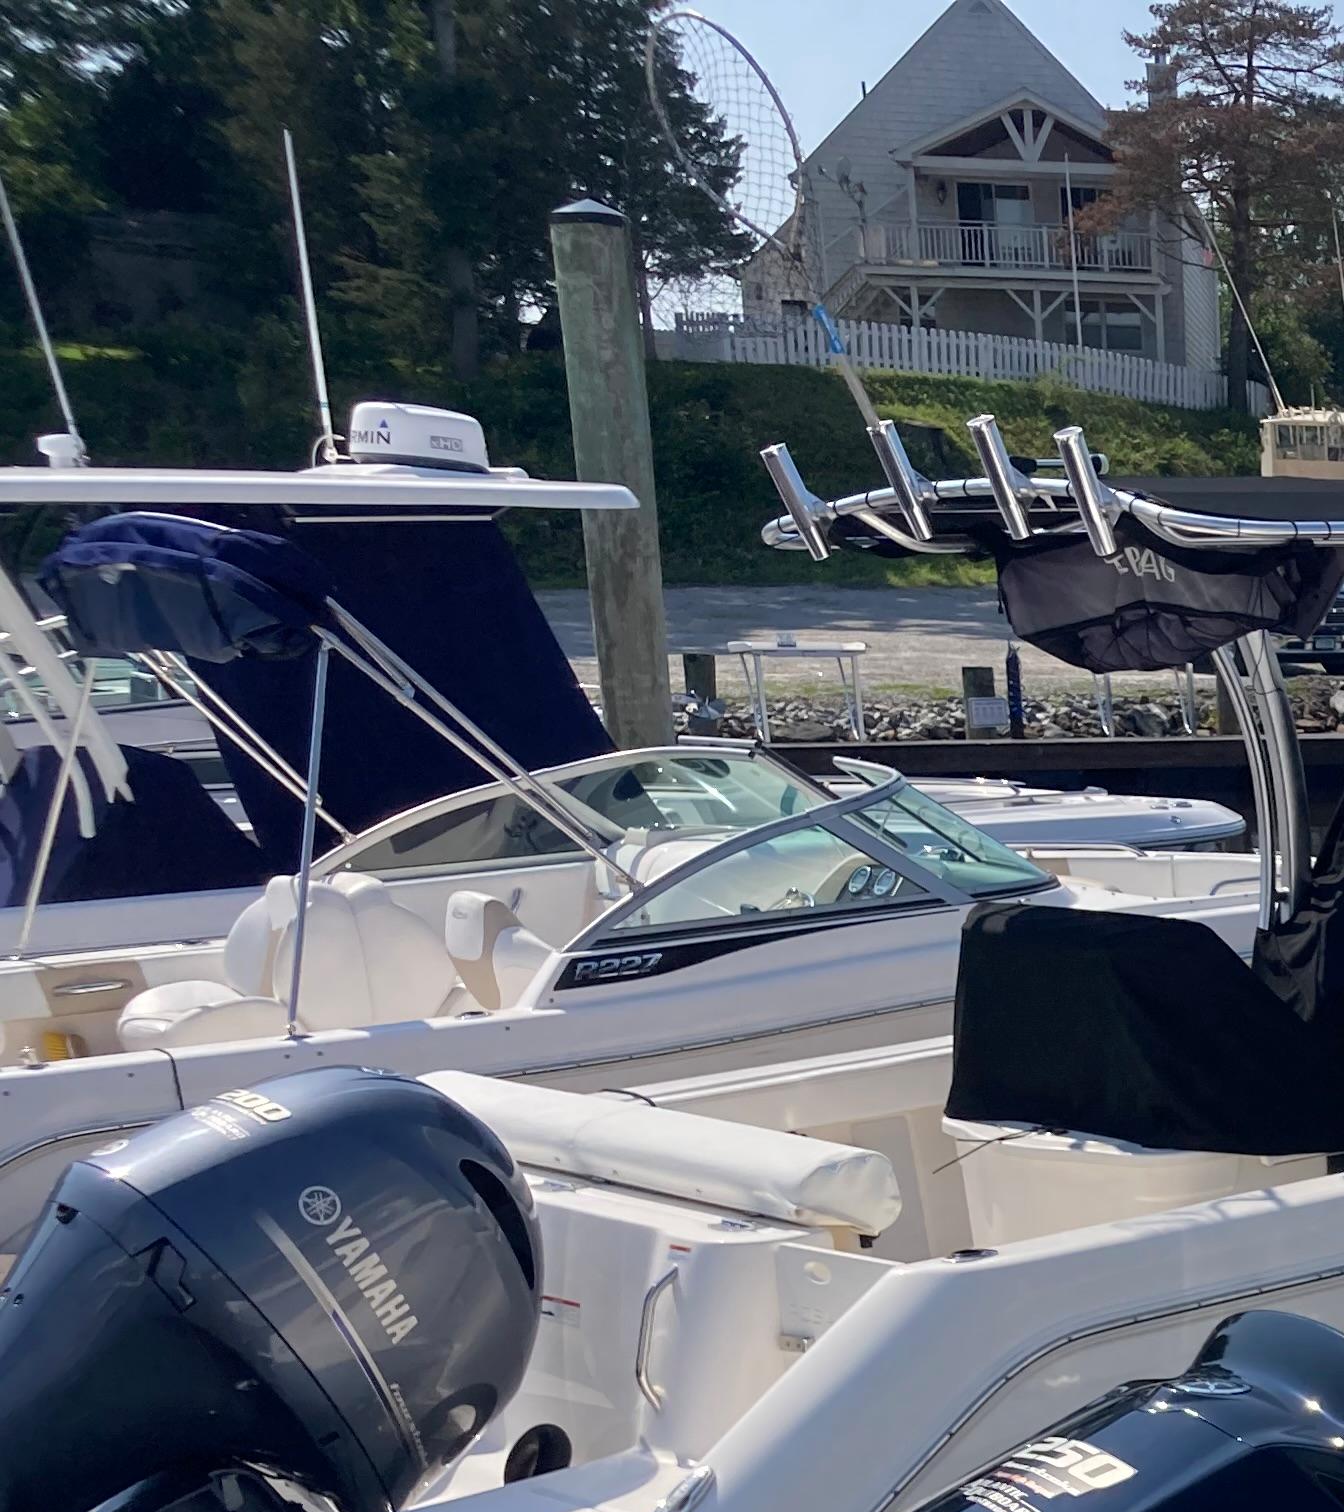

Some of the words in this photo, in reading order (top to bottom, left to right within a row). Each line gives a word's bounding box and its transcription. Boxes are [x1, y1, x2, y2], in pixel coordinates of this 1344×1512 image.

[352, 430, 391, 444] RMIN
[574, 952, 663, 981] R227
[215, 1088, 292, 1122] 200
[325, 1215, 419, 1345] YAMAHA
[1012, 1436, 1138, 1489] 250
